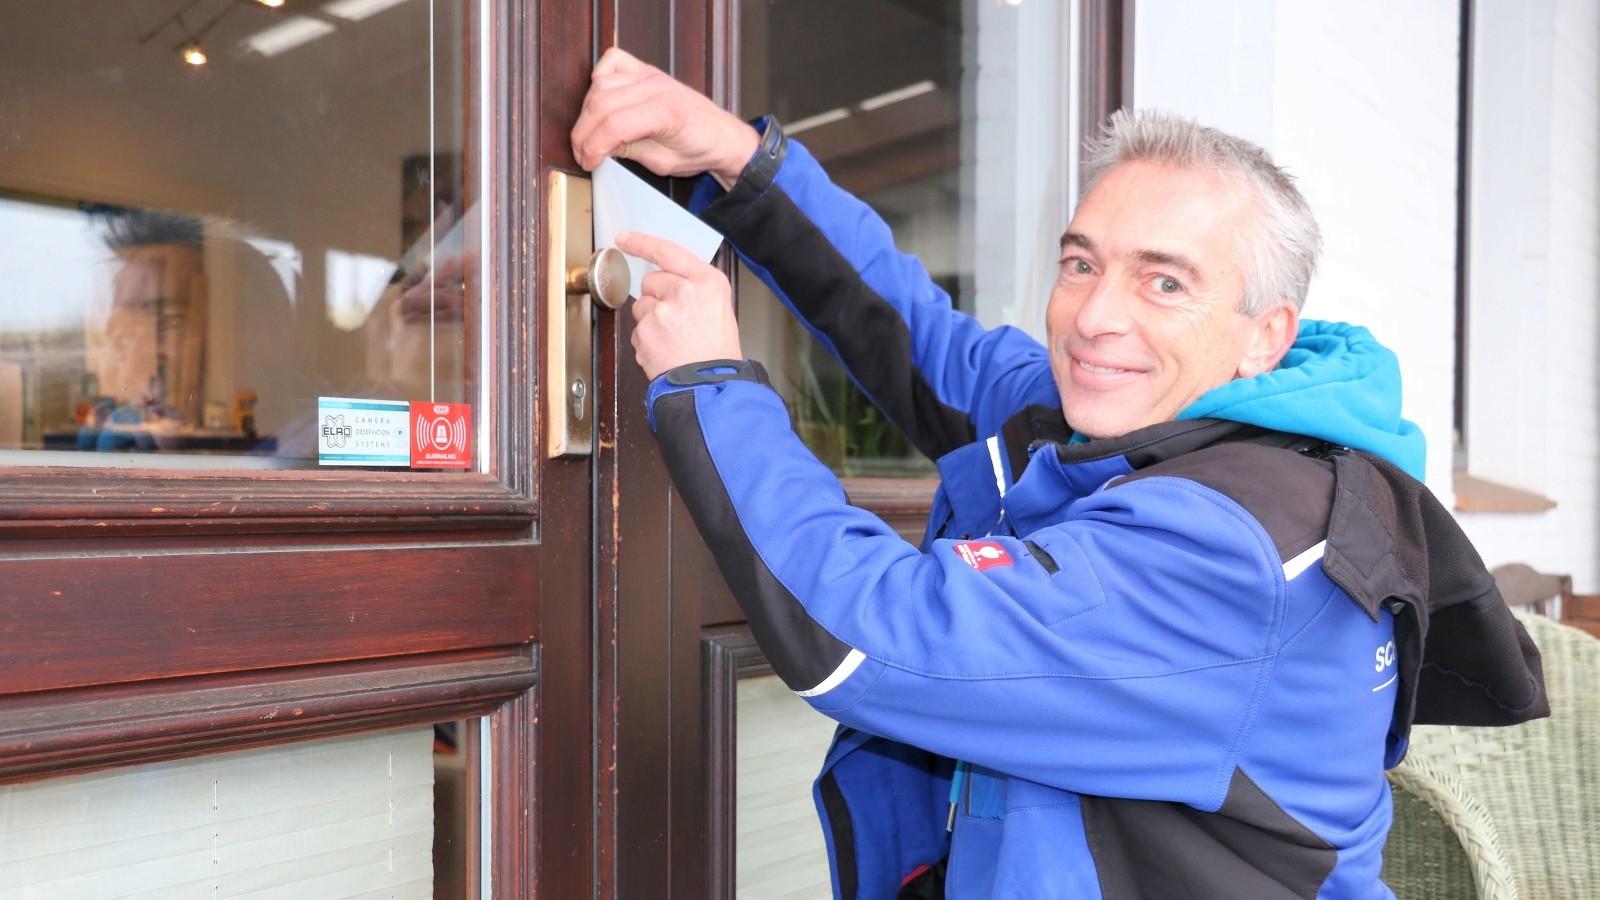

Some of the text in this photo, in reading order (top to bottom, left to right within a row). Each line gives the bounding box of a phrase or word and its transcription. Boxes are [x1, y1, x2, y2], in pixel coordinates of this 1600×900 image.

[355, 416, 390, 424] CAMERA
[323, 427, 351, 436] ELRO
[355, 428, 390, 436] OBSERVATION
